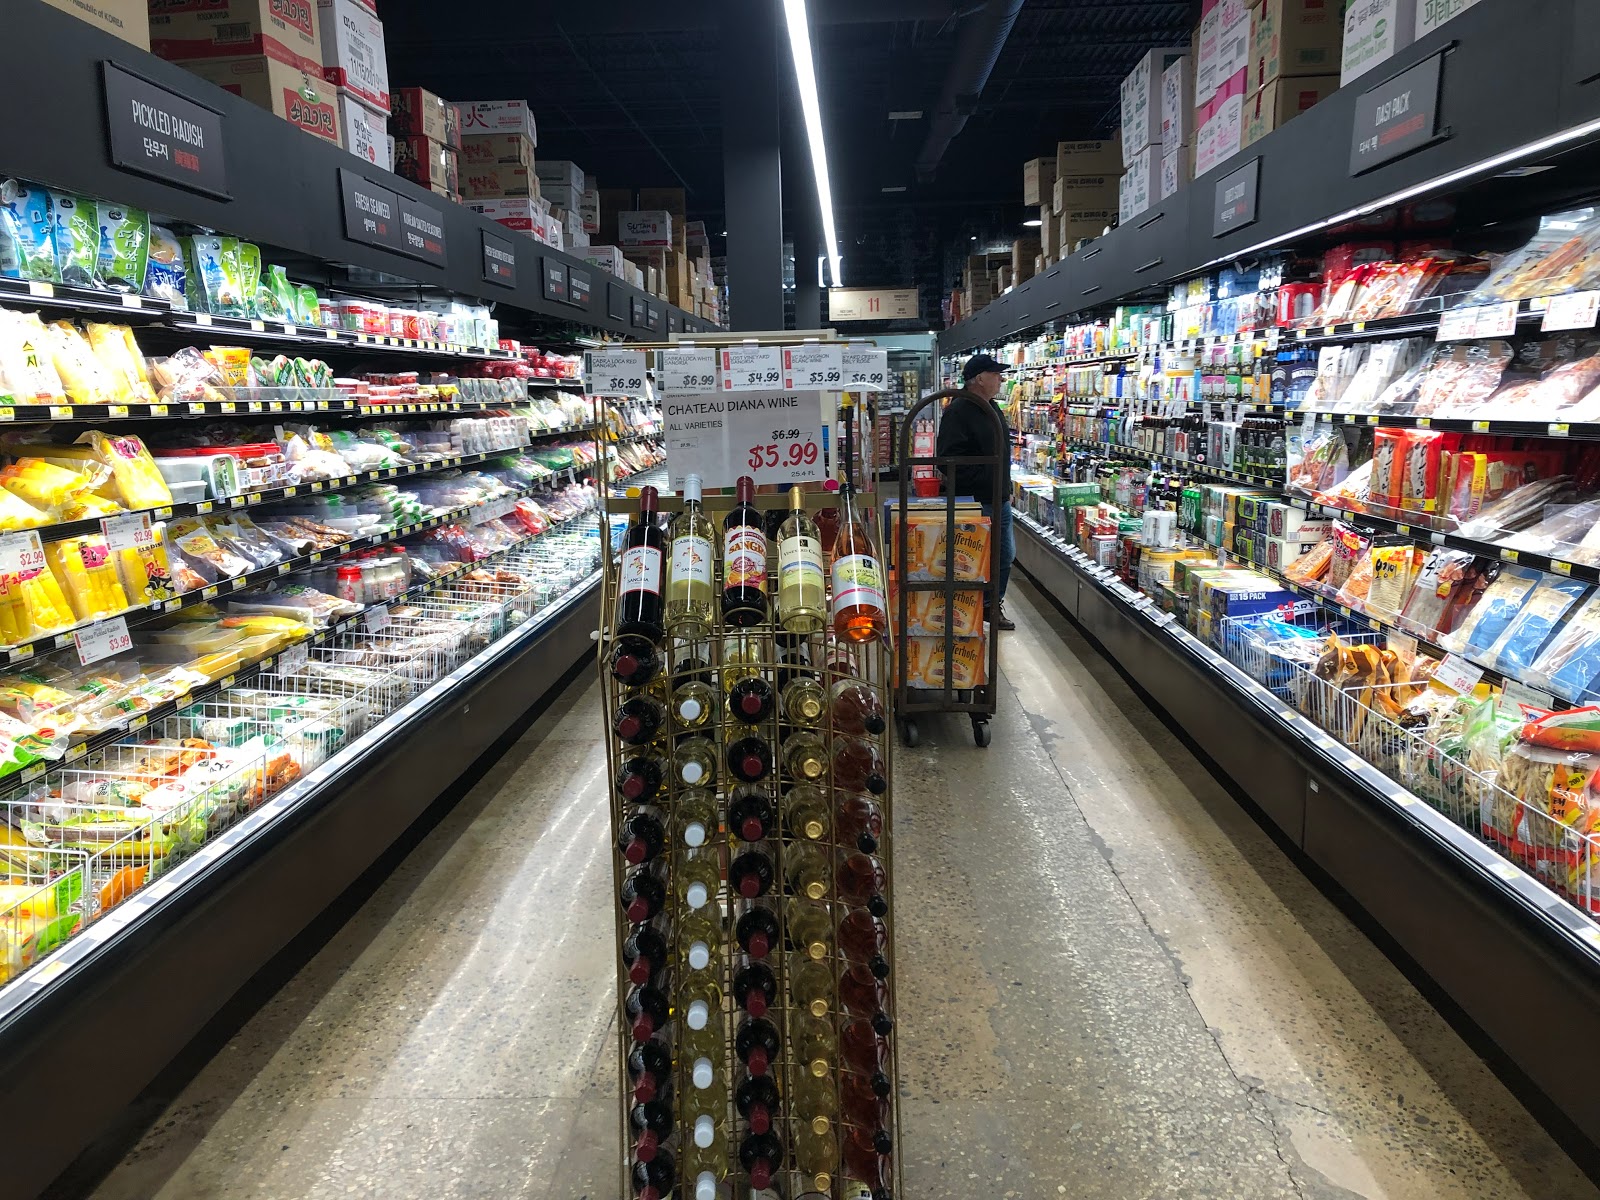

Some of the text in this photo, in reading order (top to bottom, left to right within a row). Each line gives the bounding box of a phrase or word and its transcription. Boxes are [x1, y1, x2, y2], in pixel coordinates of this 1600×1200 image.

[131, 99, 204, 149] PICKLED RADISH
[143, 137, 169, 161] 단무지
[354, 191, 391, 220] FRESH SEAWEED
[867, 297, 880, 312] 11
[1167, 361, 1180, 370] ALE
[683, 375, 714, 387] $6.99
[748, 371, 780, 384] $4.99
[809, 371, 841, 384] $5.99
[852, 373, 883, 385] $6.99
[610, 378, 641, 391] $6.99
[668, 396, 799, 416] CHATEAU DIANA WINE
[669, 420, 723, 431] ALL VARIETIES
[772, 428, 800, 441] $6.99
[748, 441, 819, 472] $5.99
[133, 529, 153, 544] $2.99
[20, 550, 44, 567] $2.99
[1238, 592, 1267, 601] 15 PACK
[109, 634, 130, 651] $3.99
[1568, 776, 1580, 789] 200
